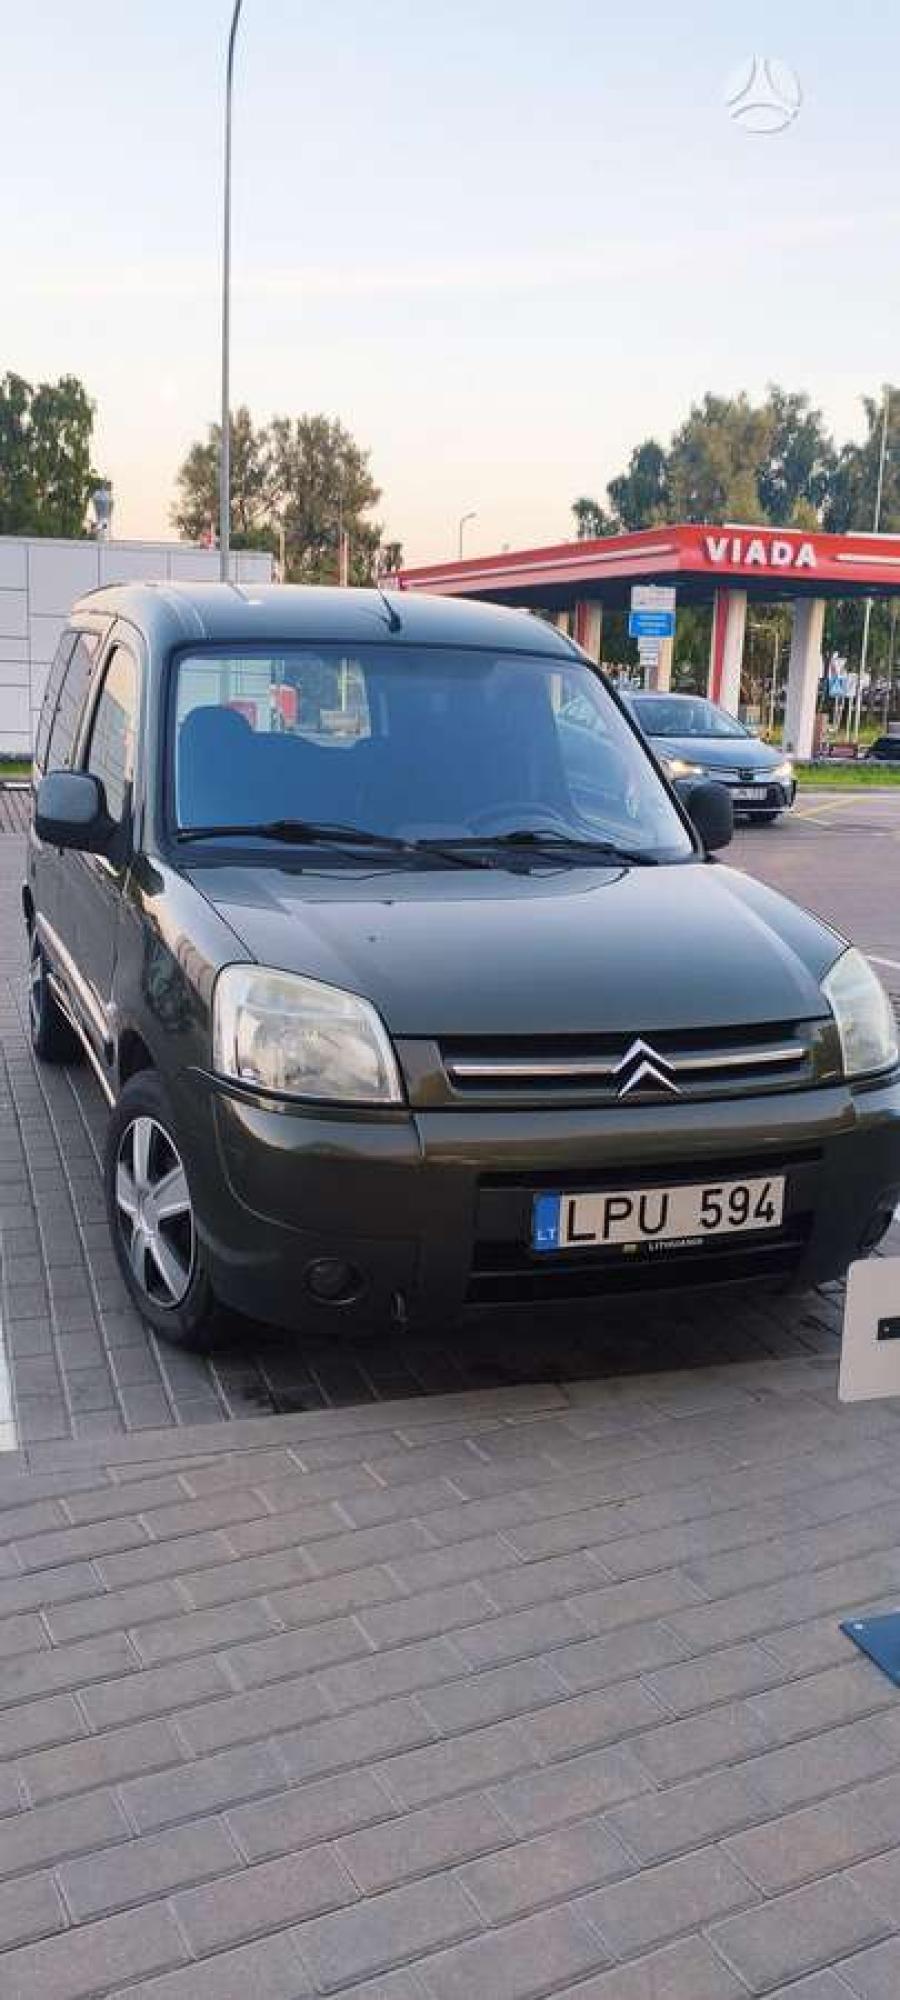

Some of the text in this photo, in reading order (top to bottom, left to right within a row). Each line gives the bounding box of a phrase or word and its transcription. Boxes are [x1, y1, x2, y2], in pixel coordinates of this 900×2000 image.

[705, 536, 816, 568] VIADA
[567, 1182, 776, 1241] LPU 594
[537, 1228, 556, 1241] LT
